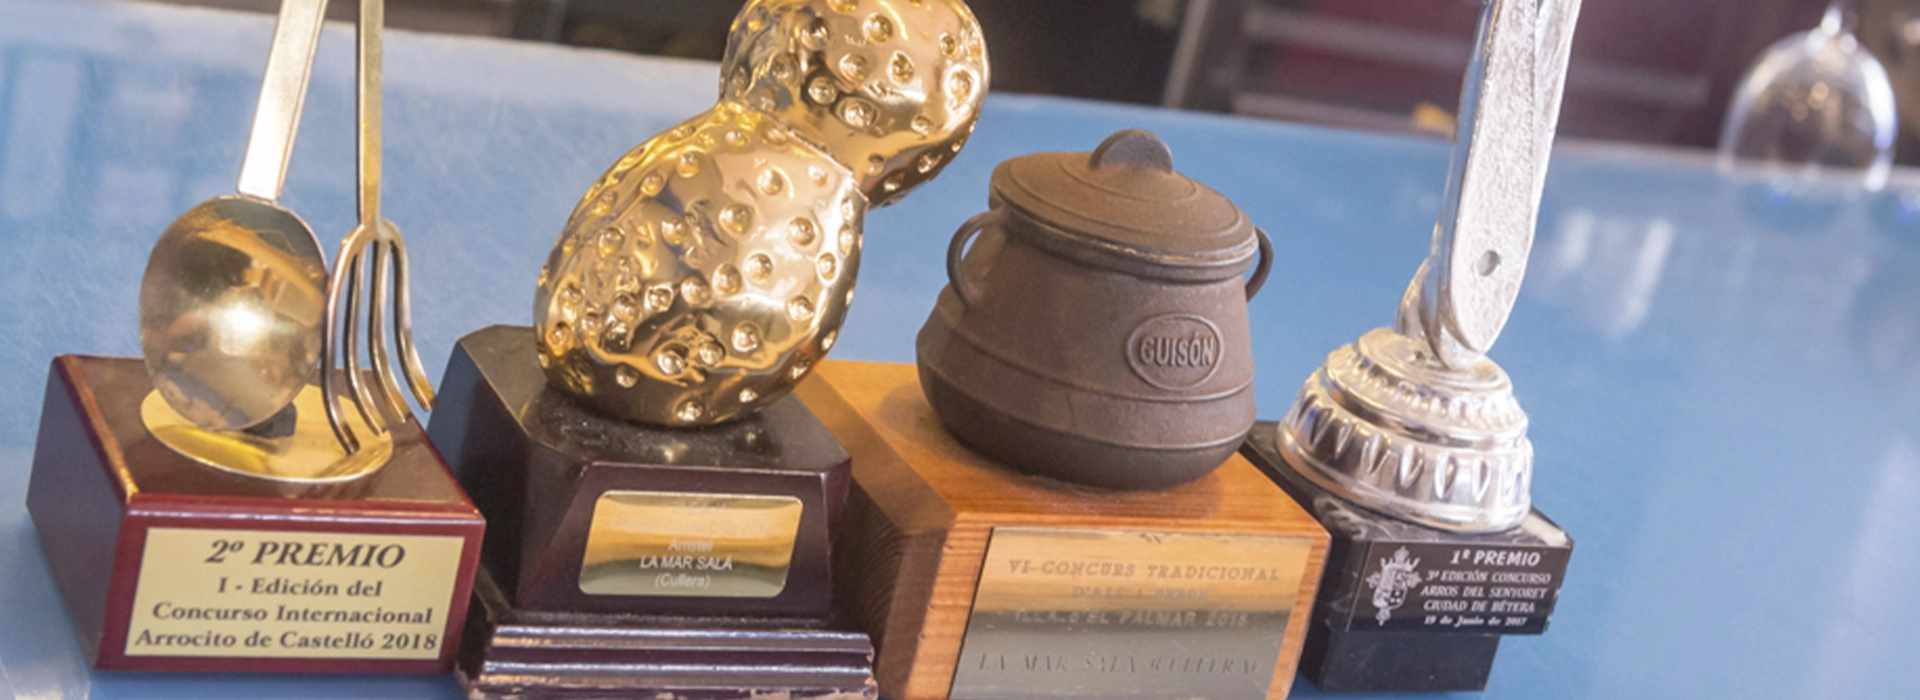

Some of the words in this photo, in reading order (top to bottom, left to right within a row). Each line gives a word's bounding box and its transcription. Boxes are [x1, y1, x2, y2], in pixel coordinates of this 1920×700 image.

[1140, 330, 1214, 367] GUISÓN
[668, 539, 713, 552] Amstel
[204, 539, 244, 564] 2º
[252, 542, 406, 568] PREMIO
[1473, 550, 1541, 566] PREMIO
[639, 555, 658, 569] LA
[660, 556, 693, 569] MAR
[697, 555, 733, 570] SALÁ
[1040, 561, 1136, 577] CONCURS
[1147, 564, 1279, 581] TRADICIONAL
[1441, 569, 1487, 582] EDICIÓN
[1491, 572, 1551, 584] CONCURSO
[218, 577, 228, 593] I
[251, 578, 339, 596] Edición
[346, 580, 382, 597] del
[655, 574, 711, 589] (Cullera)
[1420, 585, 1459, 596] ARROS
[1463, 587, 1484, 596] DEL
[1489, 587, 1548, 599] SENYORET
[153, 602, 267, 621] Concurso
[276, 605, 432, 625] Internacional
[1424, 600, 1467, 611] CIUDAD
[1471, 601, 1487, 611] DE
[1491, 599, 1535, 613] BÉTERA
[1424, 616, 1436, 625] 19
[1440, 616, 1452, 625] de
[1454, 617, 1484, 628] Junio
[1488, 617, 1501, 625] de
[135, 629, 236, 647] Arrocito
[244, 631, 271, 648] de
[279, 631, 373, 649] Castelló
[381, 634, 437, 650] 2018
